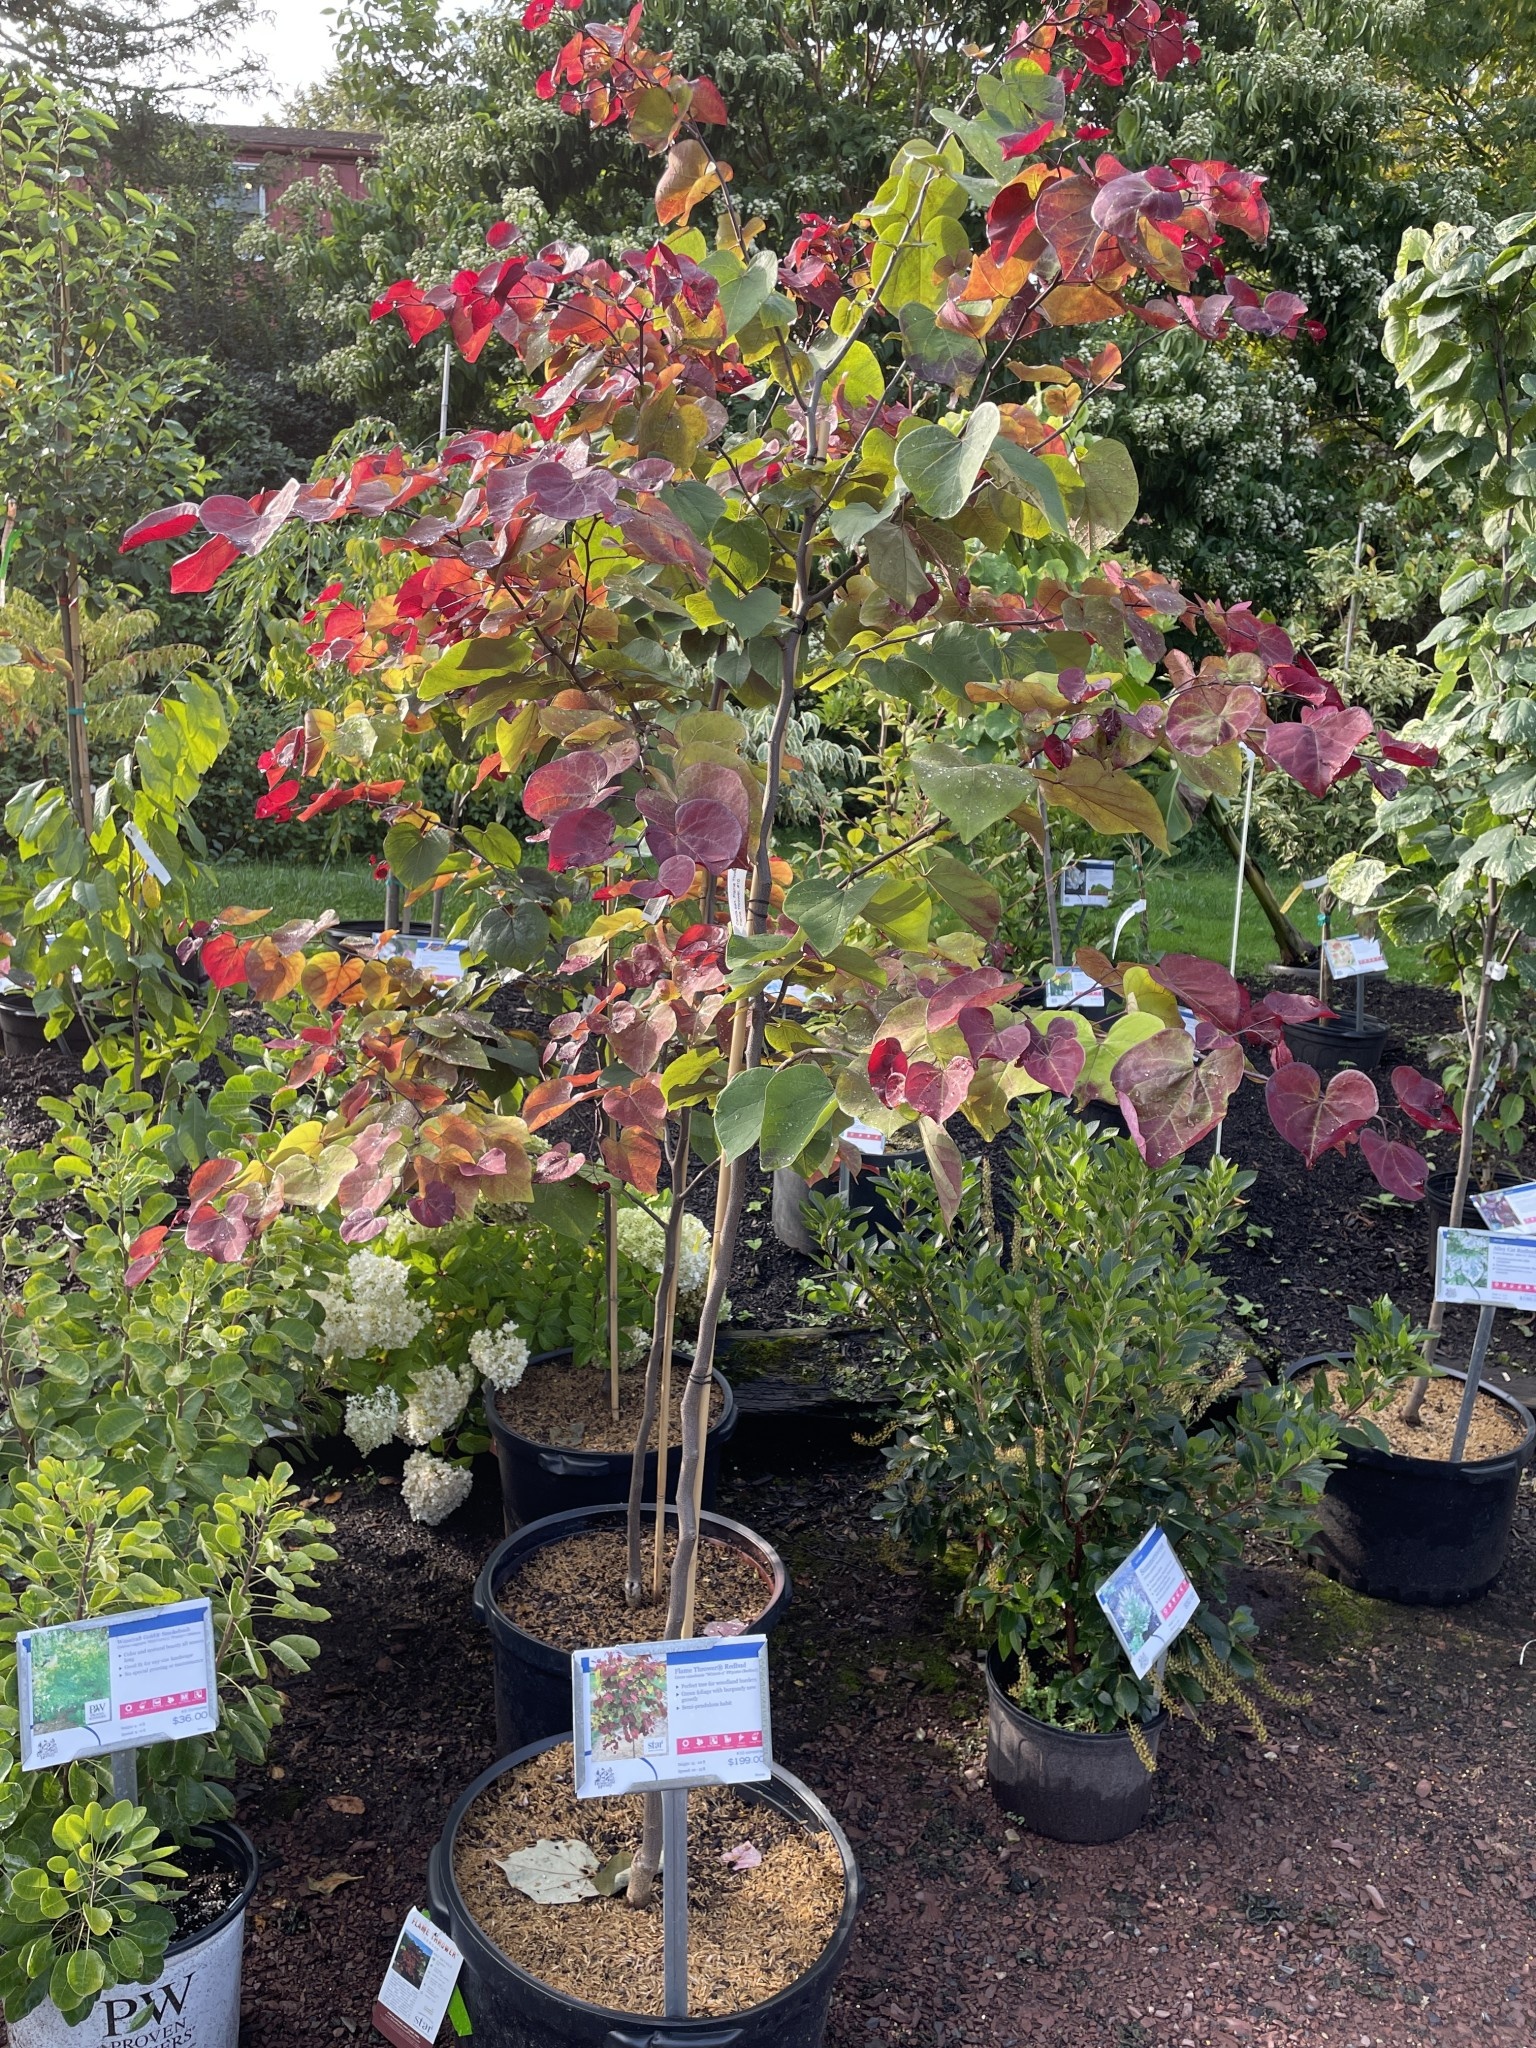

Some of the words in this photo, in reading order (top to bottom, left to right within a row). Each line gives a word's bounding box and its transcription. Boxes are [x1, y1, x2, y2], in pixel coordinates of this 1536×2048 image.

[693, 1664, 723, 1673] Thrower®
[172, 1711, 208, 1726] $36.00
[648, 1740, 663, 1749] star
[412, 1918, 429, 1936] FLAME
[431, 1934, 457, 1959] THROWER
[100, 1972, 196, 2038] PW
[112, 2017, 186, 2048] PROVEN
[414, 2015, 433, 2033] star
